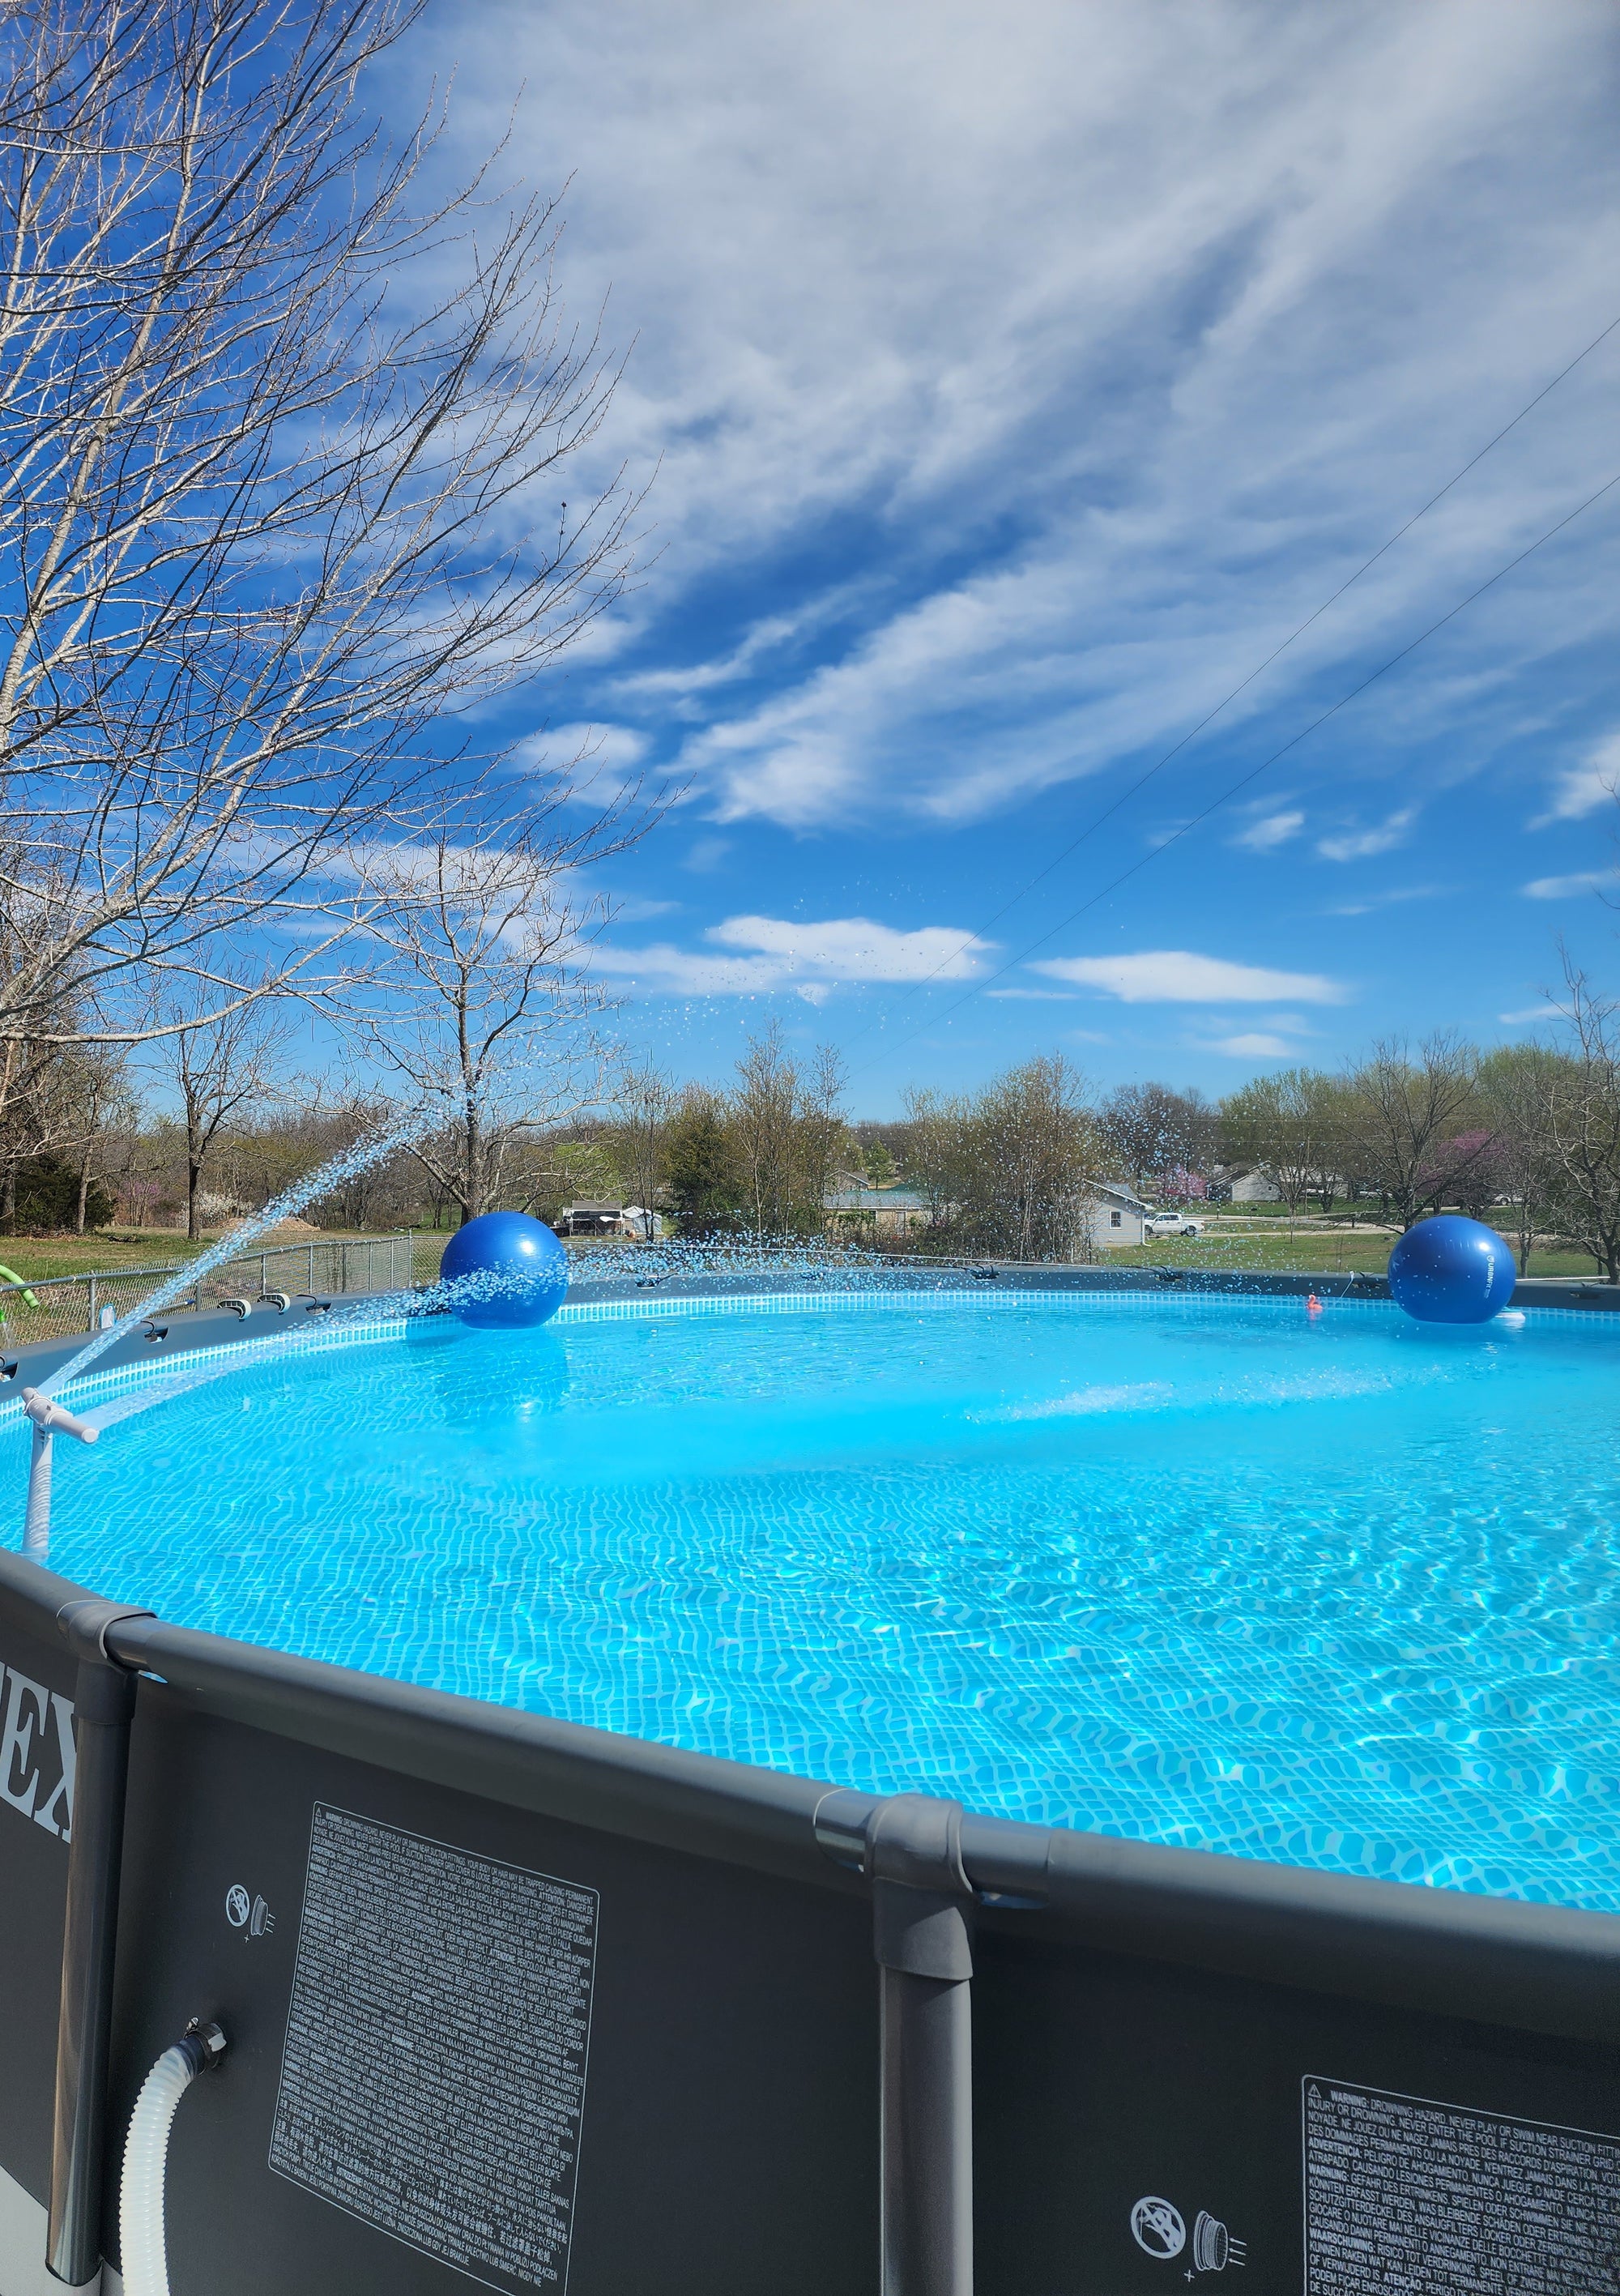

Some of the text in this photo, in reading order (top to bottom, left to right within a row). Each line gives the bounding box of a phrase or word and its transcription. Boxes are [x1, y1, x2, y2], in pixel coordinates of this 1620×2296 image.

[0, 1662, 77, 1844] EX
[518, 1875, 524, 1884] BE
[587, 1905, 594, 1916] DE
[1307, 2097, 1336, 2113] INJURY
[1337, 2103, 1349, 2116] OR
[1399, 2116, 1426, 2132] NEVER
[1428, 2123, 1455, 2139] ENTER
[1458, 2128, 1474, 2143] THE
[1476, 2132, 1497, 2147] POOL
[1500, 2137, 1507, 2149] IF
[1509, 2139, 1546, 2157] SUCTION
[1548, 2146, 1590, 2166] STRAINER
[1593, 2155, 1613, 2170] GRID
[1341, 2117, 1351, 2130] NE
[1353, 2119, 1376, 2136] JOUEZ
[1379, 2125, 1389, 2139] OU
[1392, 2127, 1401, 2140] NE
[1404, 2131, 1428, 2147] NAGEZ
[1430, 2136, 1457, 2153] JAMAIS
[1481, 2146, 1496, 2161] DES
[1498, 2150, 1541, 2170] RACCORDS
[1371, 2098, 1413, 2118] DROWNING
[1449, 2115, 1476, 2131] NEVER
[1477, 2120, 1497, 2135] PLAY
[1499, 2124, 1511, 2137] OR
[1513, 2127, 1535, 2142] SWIM
[1536, 2132, 1558, 2147] NEAR
[1560, 2136, 1595, 2154] SUCTION
[1308, 2123, 1323, 2136] DES
[1325, 2127, 1368, 2147] DOMMAGES
[1370, 2136, 1422, 2158] PERMANENTS
[1423, 2148, 1435, 2162] OU
[1436, 2151, 1447, 2164] LA
[1555, 2175, 1577, 2191] DANS
[1352, 2159, 1394, 2179] CAUSANDO
[1396, 2169, 1434, 2188] LESIONES
[1364, 2149, 1397, 2166] PELIGRO
[1399, 2156, 1409, 2170] DE
[1472, 2172, 1498, 2188] NUNCA
[1501, 2178, 1533, 2196] JUEGUE
[1350, 2172, 1380, 2190] GEFAHR
[1383, 2179, 1397, 2194] DES
[1486, 2201, 1507, 2217] ODER
[1396, 2209, 1413, 2223] DES
[1418, 2200, 1435, 2215] WAS
[1377, 2243, 1404, 2260] RISICO
[1405, 2249, 1420, 2264] TOT
